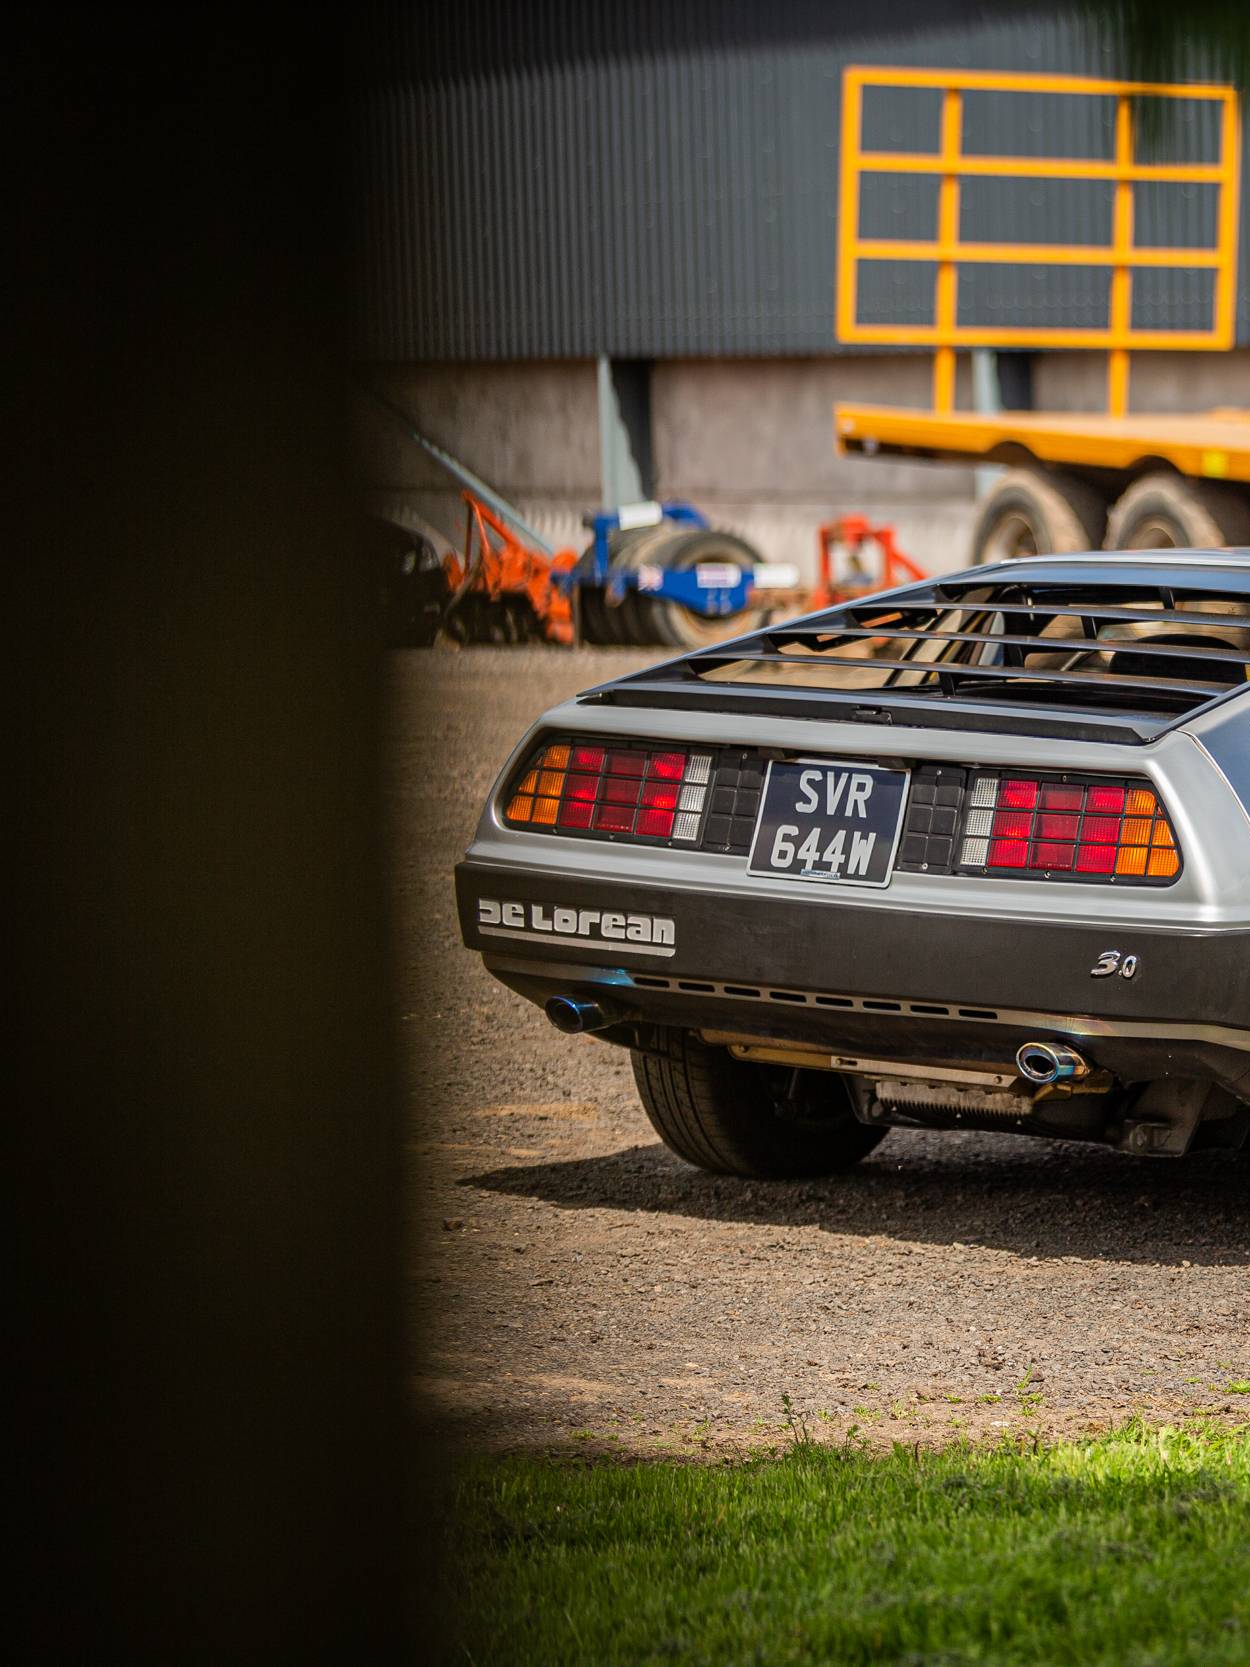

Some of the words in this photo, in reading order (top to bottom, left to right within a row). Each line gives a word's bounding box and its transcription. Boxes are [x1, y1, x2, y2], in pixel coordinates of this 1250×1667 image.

[795, 770, 874, 818] SVR
[770, 824, 877, 876] 644W
[1090, 950, 1137, 978] 3.0
